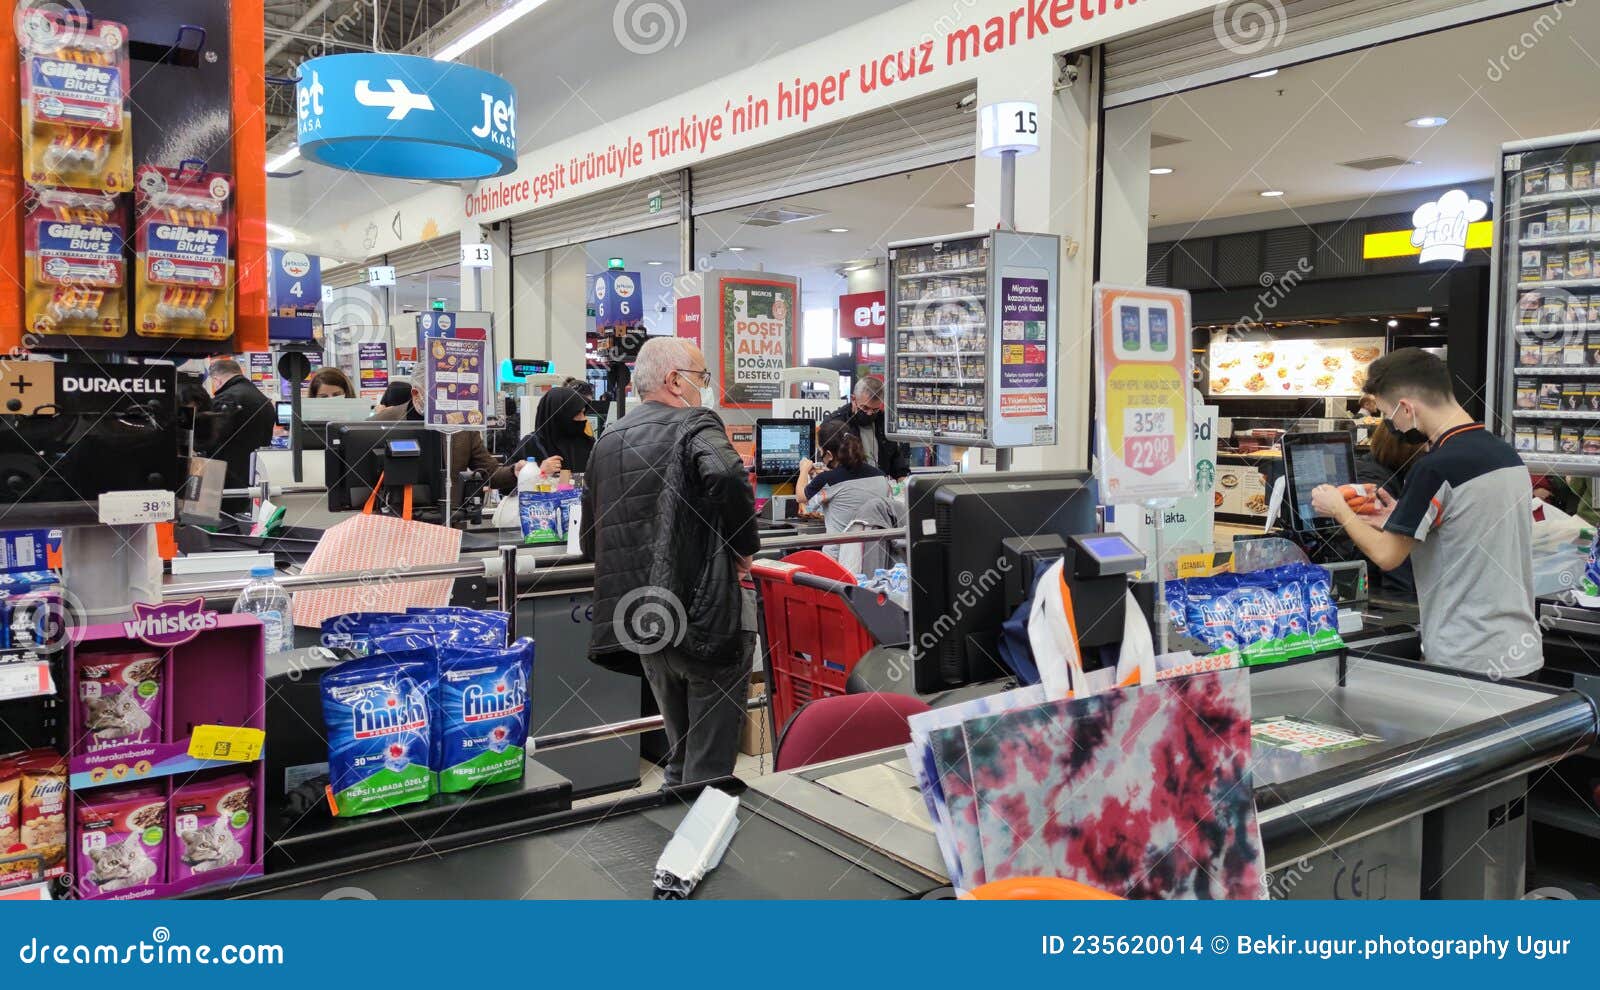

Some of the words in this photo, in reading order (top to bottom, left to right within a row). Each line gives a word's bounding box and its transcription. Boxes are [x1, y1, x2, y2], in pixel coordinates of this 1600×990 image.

[41, 61, 111, 84] Gillette
[298, 71, 324, 120] et
[472, 92, 516, 138] Jet
[1014, 110, 1037, 134] 15
[465, 180, 528, 218] Onbinlerce
[533, 163, 565, 204] çeşit
[569, 135, 643, 187] ürünüyle
[648, 93, 769, 161] Türkiye'nin
[777, 66, 850, 122] hiper
[859, 40, 933, 94] ucuz
[48, 224, 114, 242] Gillette
[156, 225, 218, 245] Gillette
[475, 247, 489, 261] 13
[290, 281, 304, 298] 4
[620, 301, 630, 315] 6
[736, 321, 784, 340] POŞET
[737, 338, 784, 356] ALMA
[737, 355, 785, 370] DOĞAYA
[737, 370, 772, 380] DESTEK
[62, 377, 166, 394] DURACELL
[1134, 412, 1154, 433] 35
[1132, 440, 1154, 468] 22
[142, 501, 159, 512] 38
[124, 610, 217, 639] whiskas
[463, 680, 525, 717] finish
[353, 694, 427, 734] finish
[463, 739, 473, 748] 30
[354, 757, 366, 767] 30
[178, 817, 194, 831] 1+
[84, 833, 102, 848] 1+
